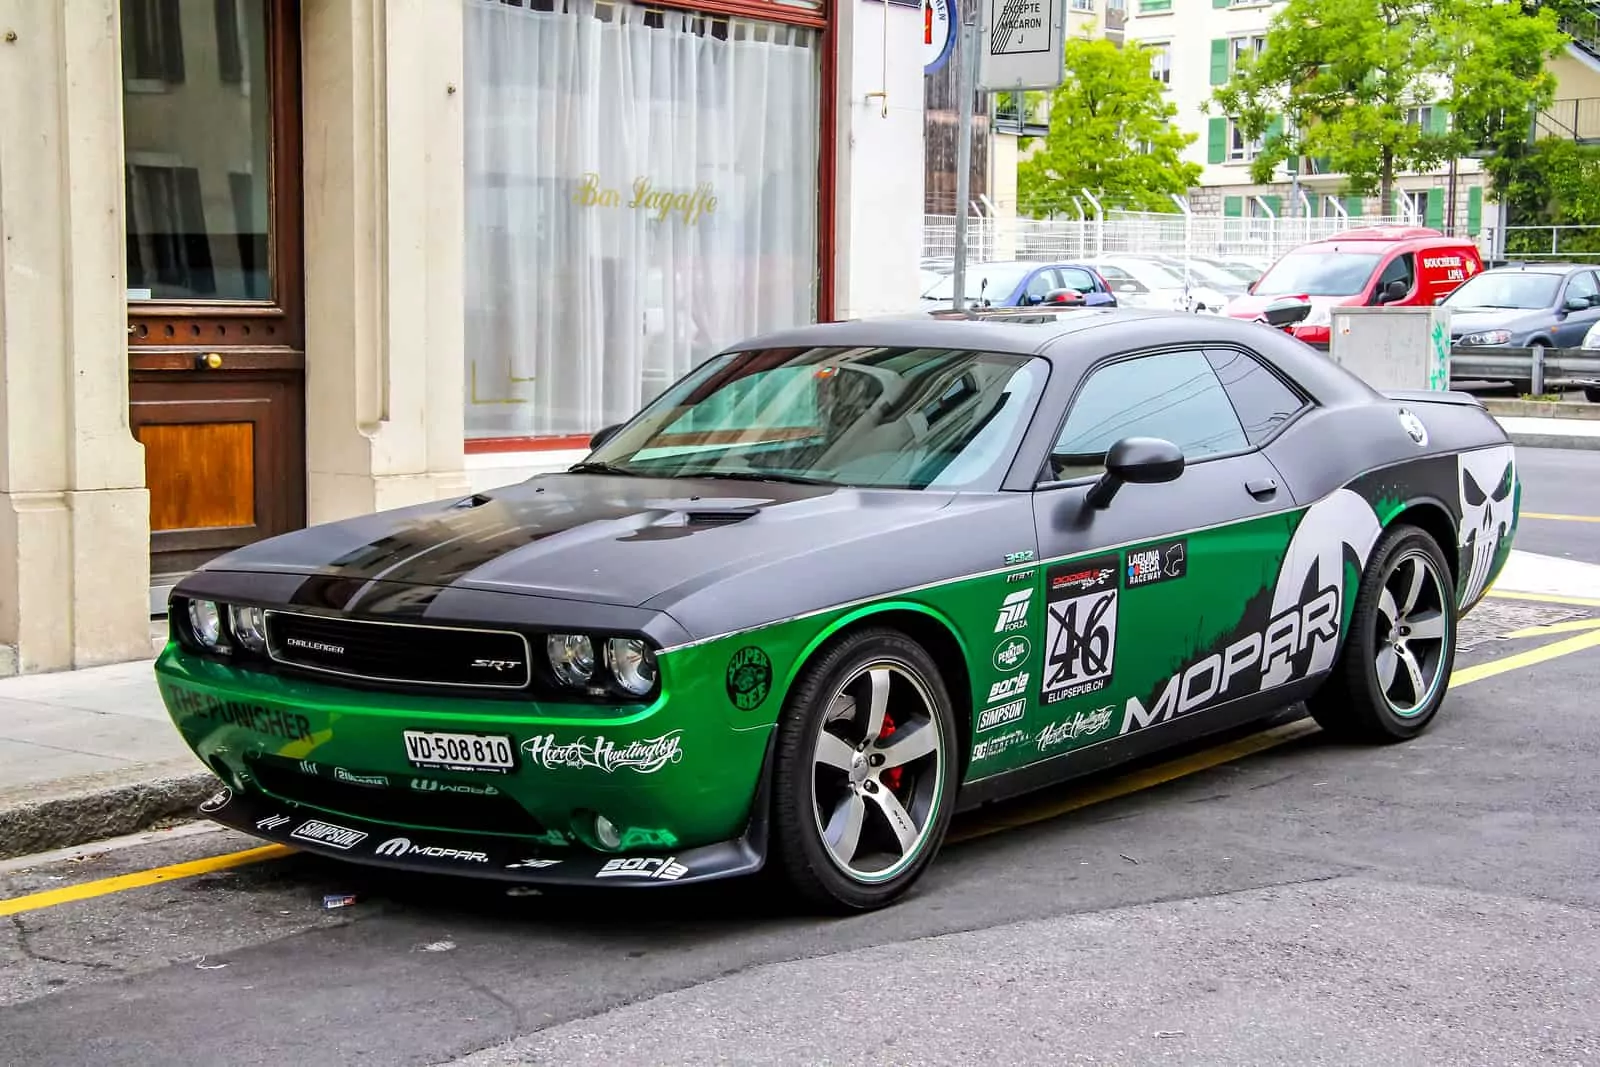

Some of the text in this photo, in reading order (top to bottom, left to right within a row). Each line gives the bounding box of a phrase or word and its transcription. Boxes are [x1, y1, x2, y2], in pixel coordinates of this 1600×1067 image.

[572, 171, 717, 226] Bar Lagaffe
[1003, 550, 1034, 565] 392
[1128, 549, 1160, 566] LAGUNA
[1139, 560, 1160, 574] SECA
[1129, 569, 1162, 585] RACEWAY
[1005, 619, 1028, 632] FORZA
[287, 638, 345, 655] CHALLENGER
[471, 658, 522, 671] SRT
[1119, 590, 1337, 735] MOPAR
[1047, 679, 1104, 703] ELLIPSEPUB.CH
[168, 685, 315, 745] THE PUNISHER
[980, 701, 1023, 729] SIMPSON
[300, 822, 359, 846] SIMPSON
